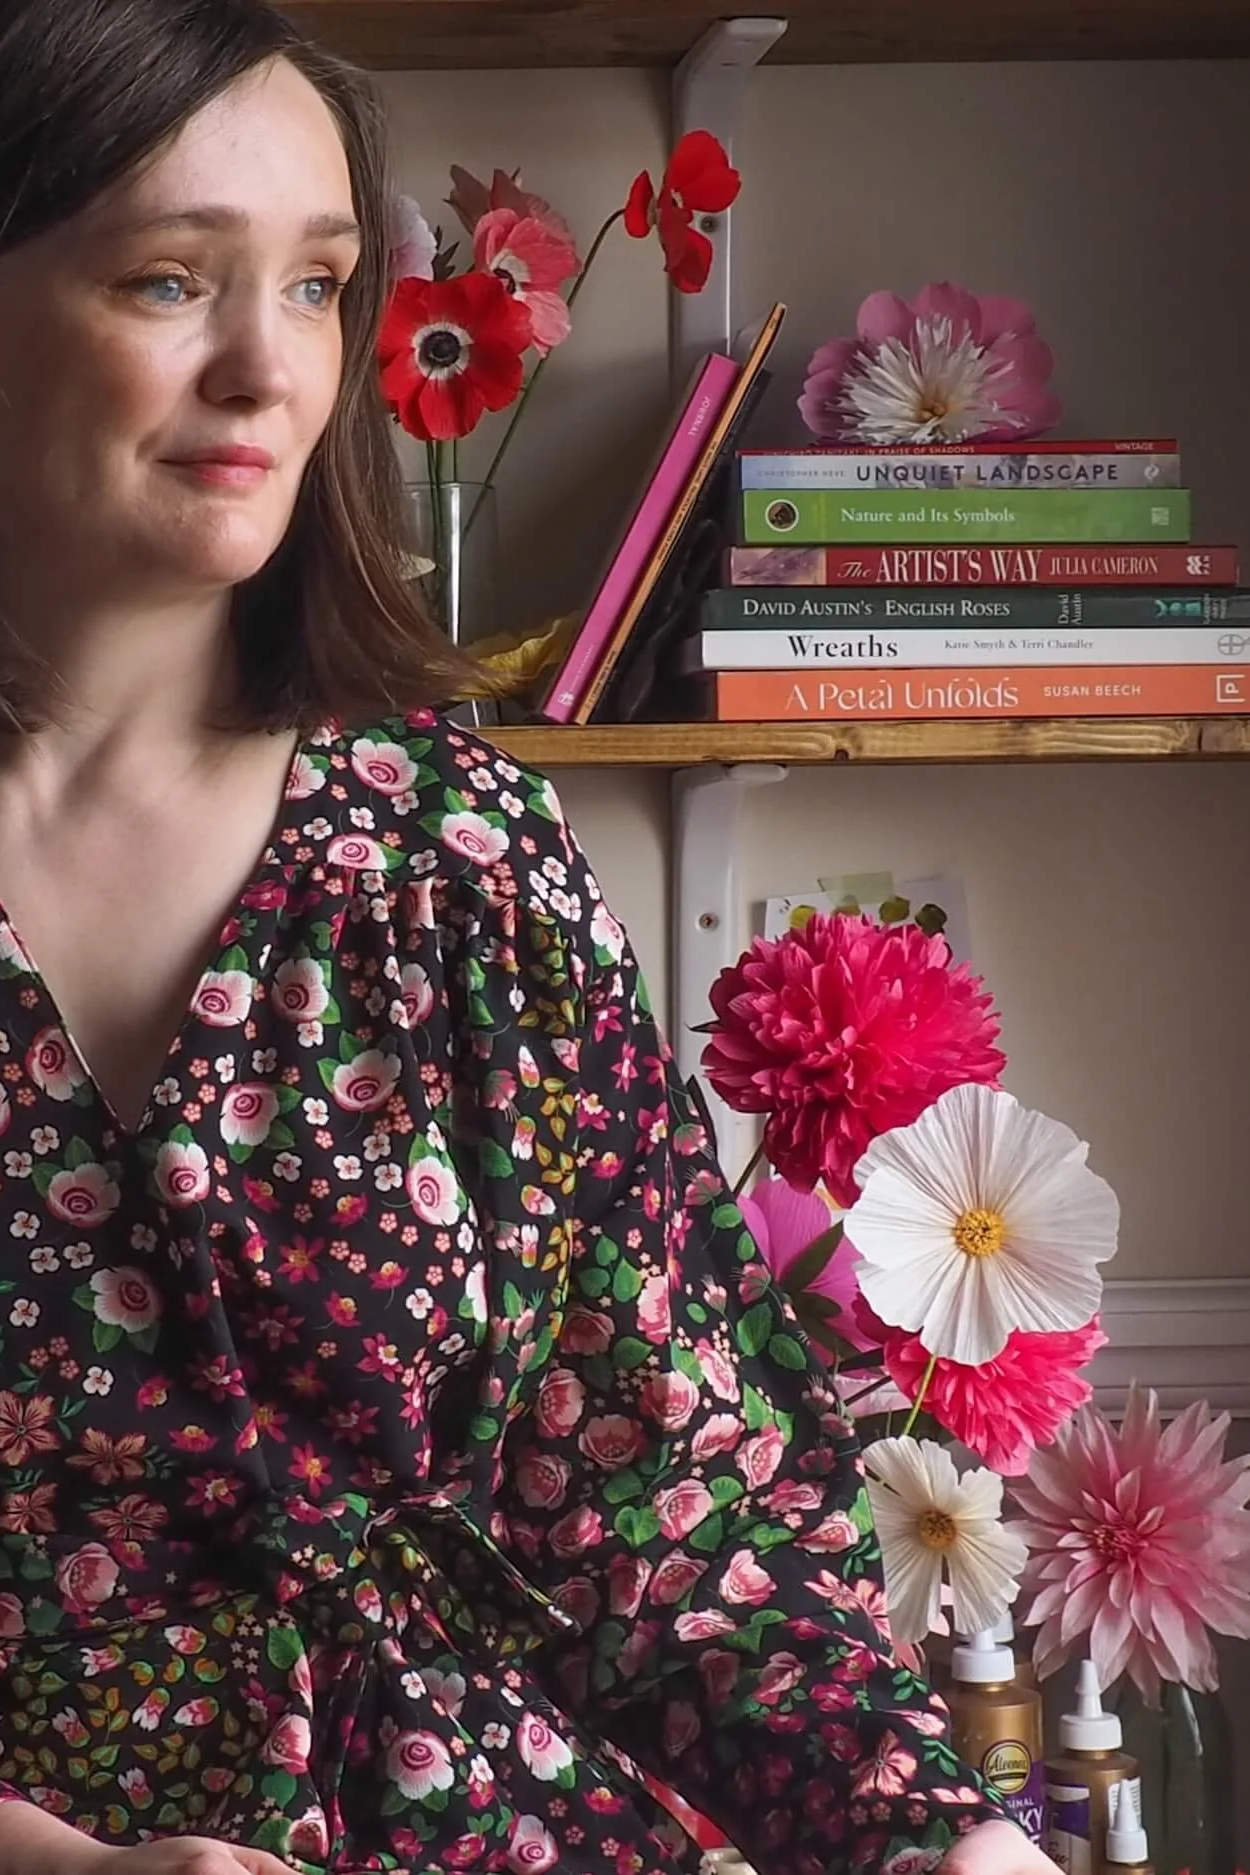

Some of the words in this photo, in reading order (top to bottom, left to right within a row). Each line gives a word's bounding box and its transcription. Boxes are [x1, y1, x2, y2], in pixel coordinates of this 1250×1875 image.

[1114, 442, 1154, 451] VINTAGE
[856, 465, 965, 481] UNQUIET
[977, 465, 1118, 480] LANDSCAPE
[841, 509, 894, 522] Nature
[898, 508, 925, 522] and
[930, 508, 948, 522] Its
[953, 508, 1015, 525] Symbols
[837, 561, 873, 578] The
[876, 550, 983, 583] ARTIST'S
[990, 550, 1042, 583] WAY
[1050, 557, 1088, 575] JULIA
[1091, 556, 1159, 575] CAMERON
[743, 599, 796, 616] DAVID
[885, 600, 955, 616] ENGLISH
[961, 600, 1011, 616] ROSES
[1058, 594, 1069, 624] David
[1071, 593, 1082, 625] Austin
[788, 634, 899, 658] Wreaths
[945, 639, 970, 650] Katie
[973, 639, 1005, 652] Smyth
[1008, 639, 1018, 649] &
[1021, 639, 1045, 649] Terri
[1047, 639, 1094, 650] Chandler
[785, 684, 808, 711] A
[819, 679, 893, 711] Petal
[904, 677, 1019, 710] Unfolds
[1043, 685, 1089, 697] SUSAN
[1095, 685, 1141, 697] BEECH
